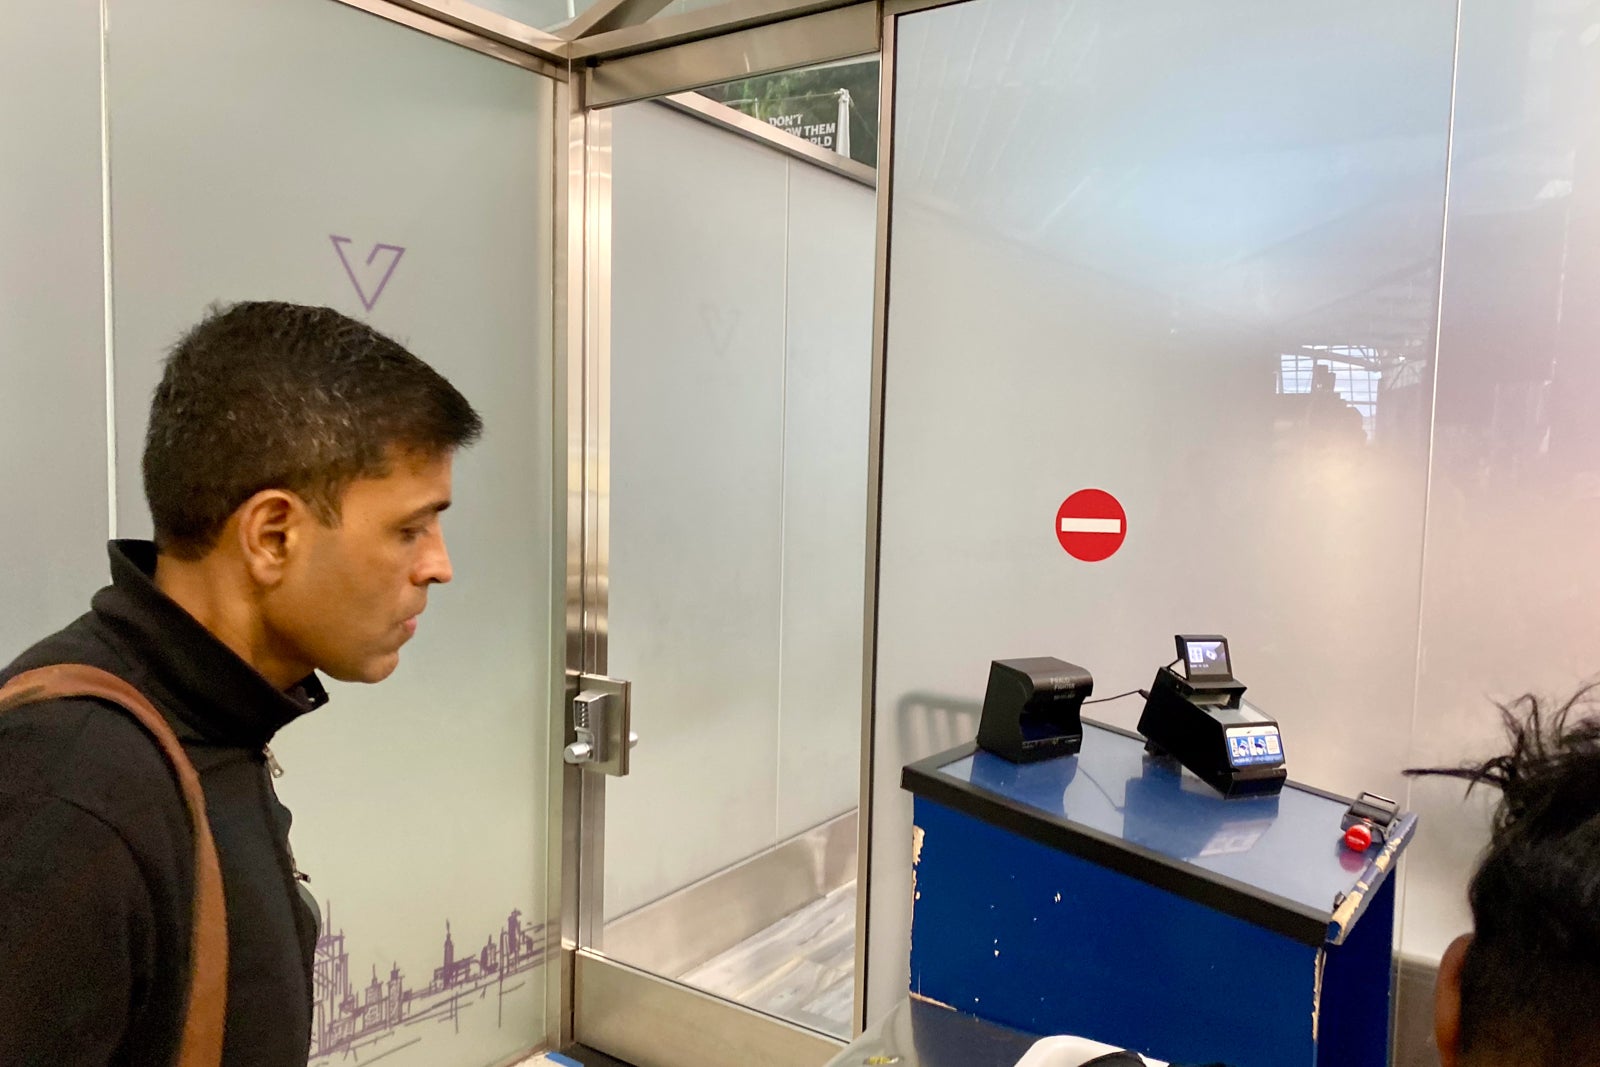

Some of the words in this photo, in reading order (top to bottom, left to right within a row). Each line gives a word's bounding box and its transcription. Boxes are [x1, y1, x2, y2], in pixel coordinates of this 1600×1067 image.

[769, 113, 803, 127] DON'T
[804, 123, 836, 136] THEM
[803, 136, 832, 147] RLD
